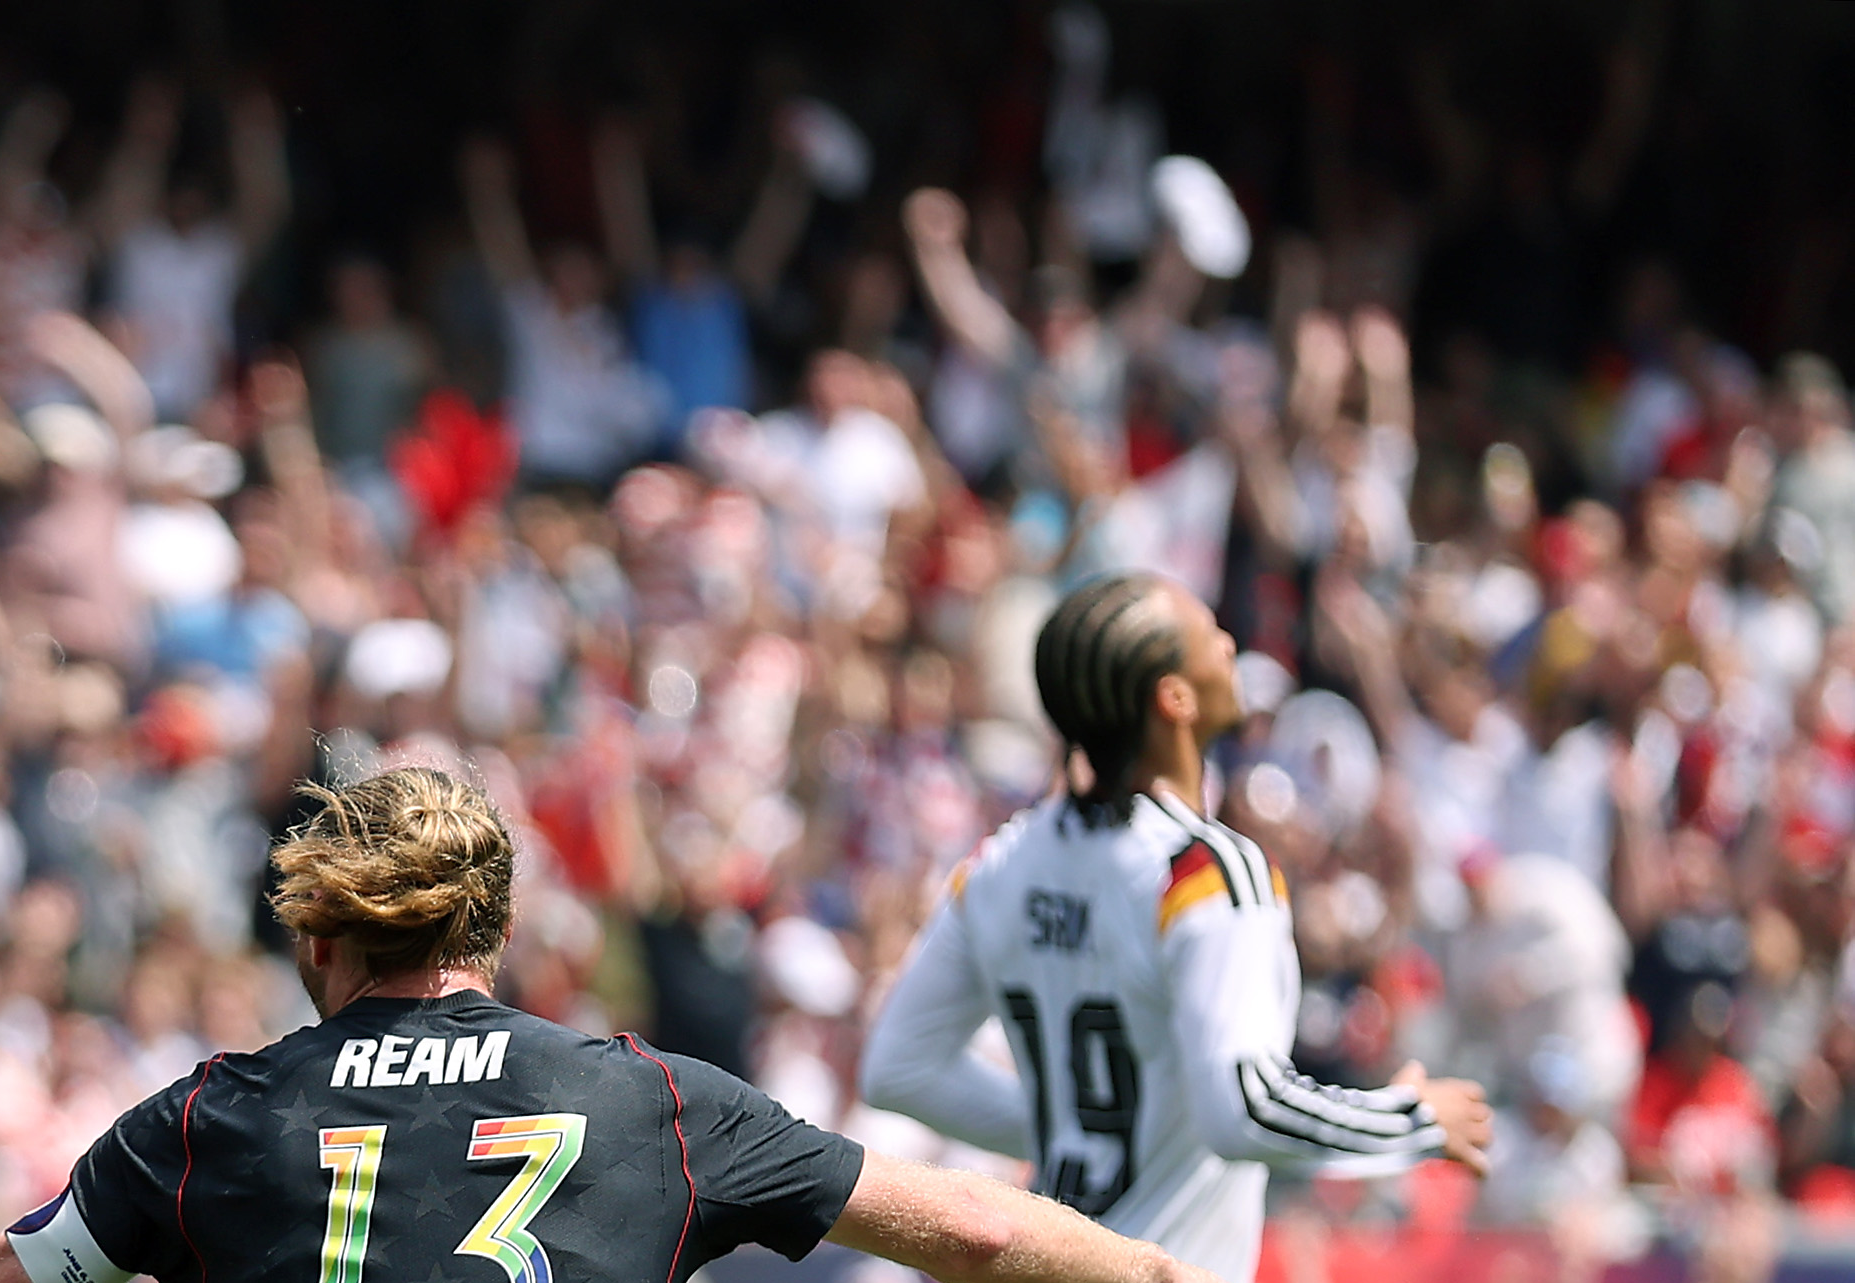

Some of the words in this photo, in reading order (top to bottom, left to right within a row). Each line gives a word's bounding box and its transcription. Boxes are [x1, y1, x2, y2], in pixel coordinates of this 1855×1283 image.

[330, 1031, 512, 1087] REAM
[1002, 987, 1140, 1216] 19
[62, 1247, 83, 1273] JUNE
